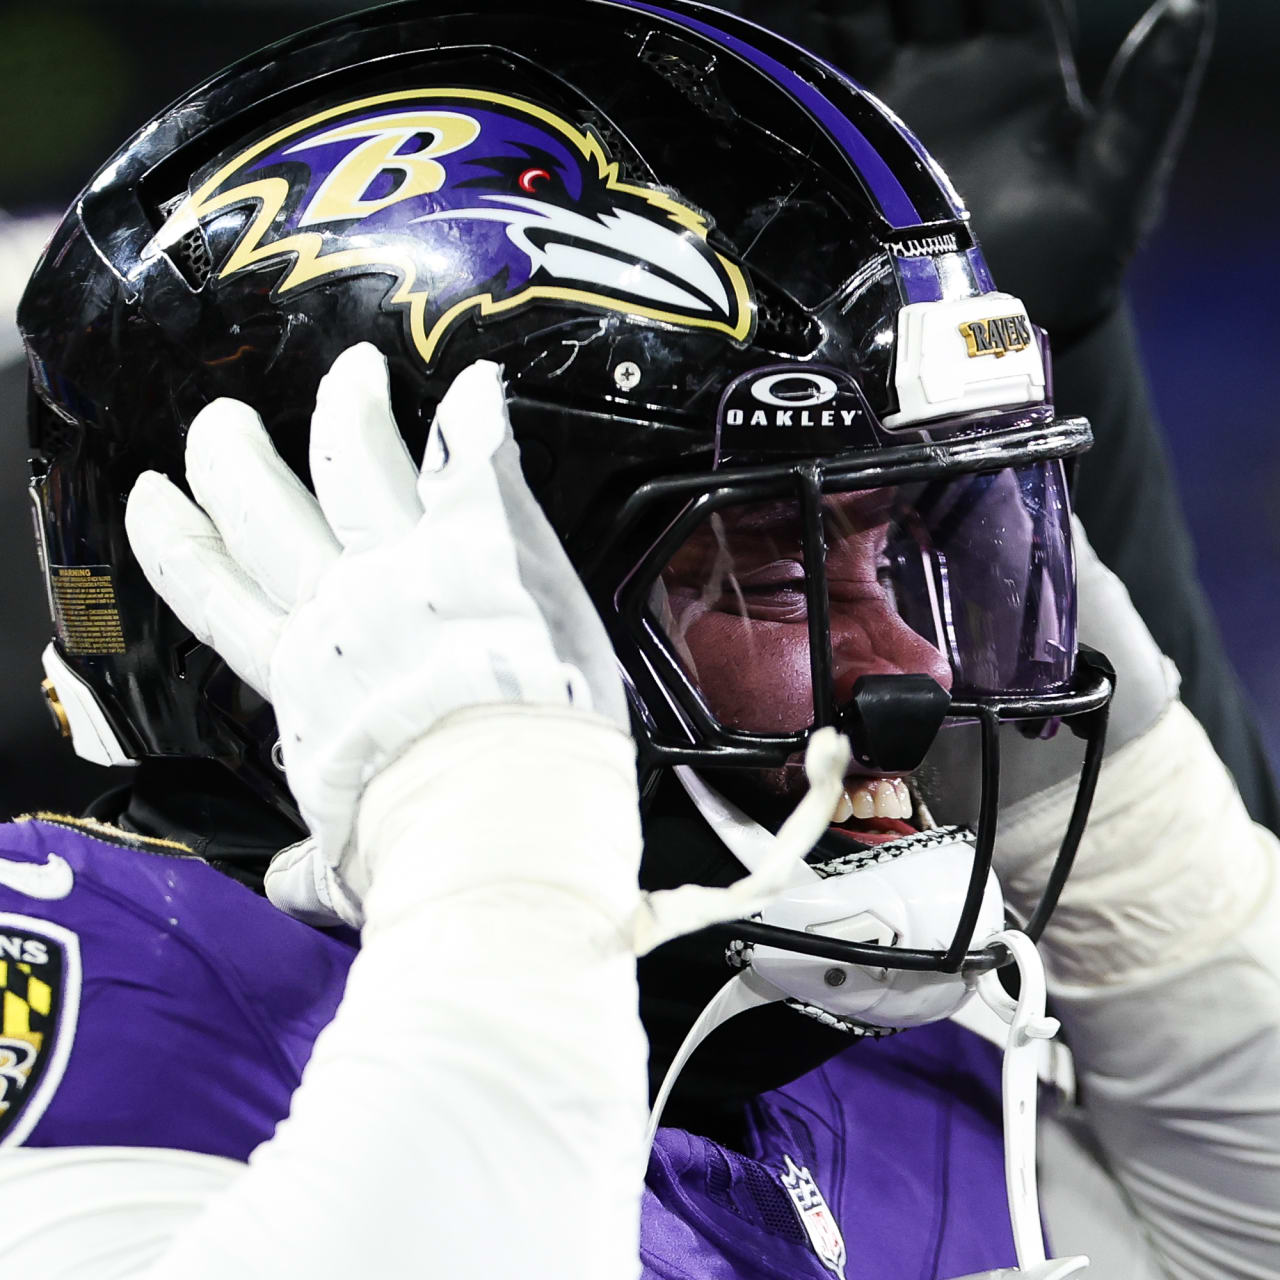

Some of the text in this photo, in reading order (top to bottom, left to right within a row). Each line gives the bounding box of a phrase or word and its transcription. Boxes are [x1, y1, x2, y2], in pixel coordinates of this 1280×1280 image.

[281, 111, 481, 229] B
[968, 315, 1031, 352] RAVENS
[727, 409, 856, 426] OAKLEY
